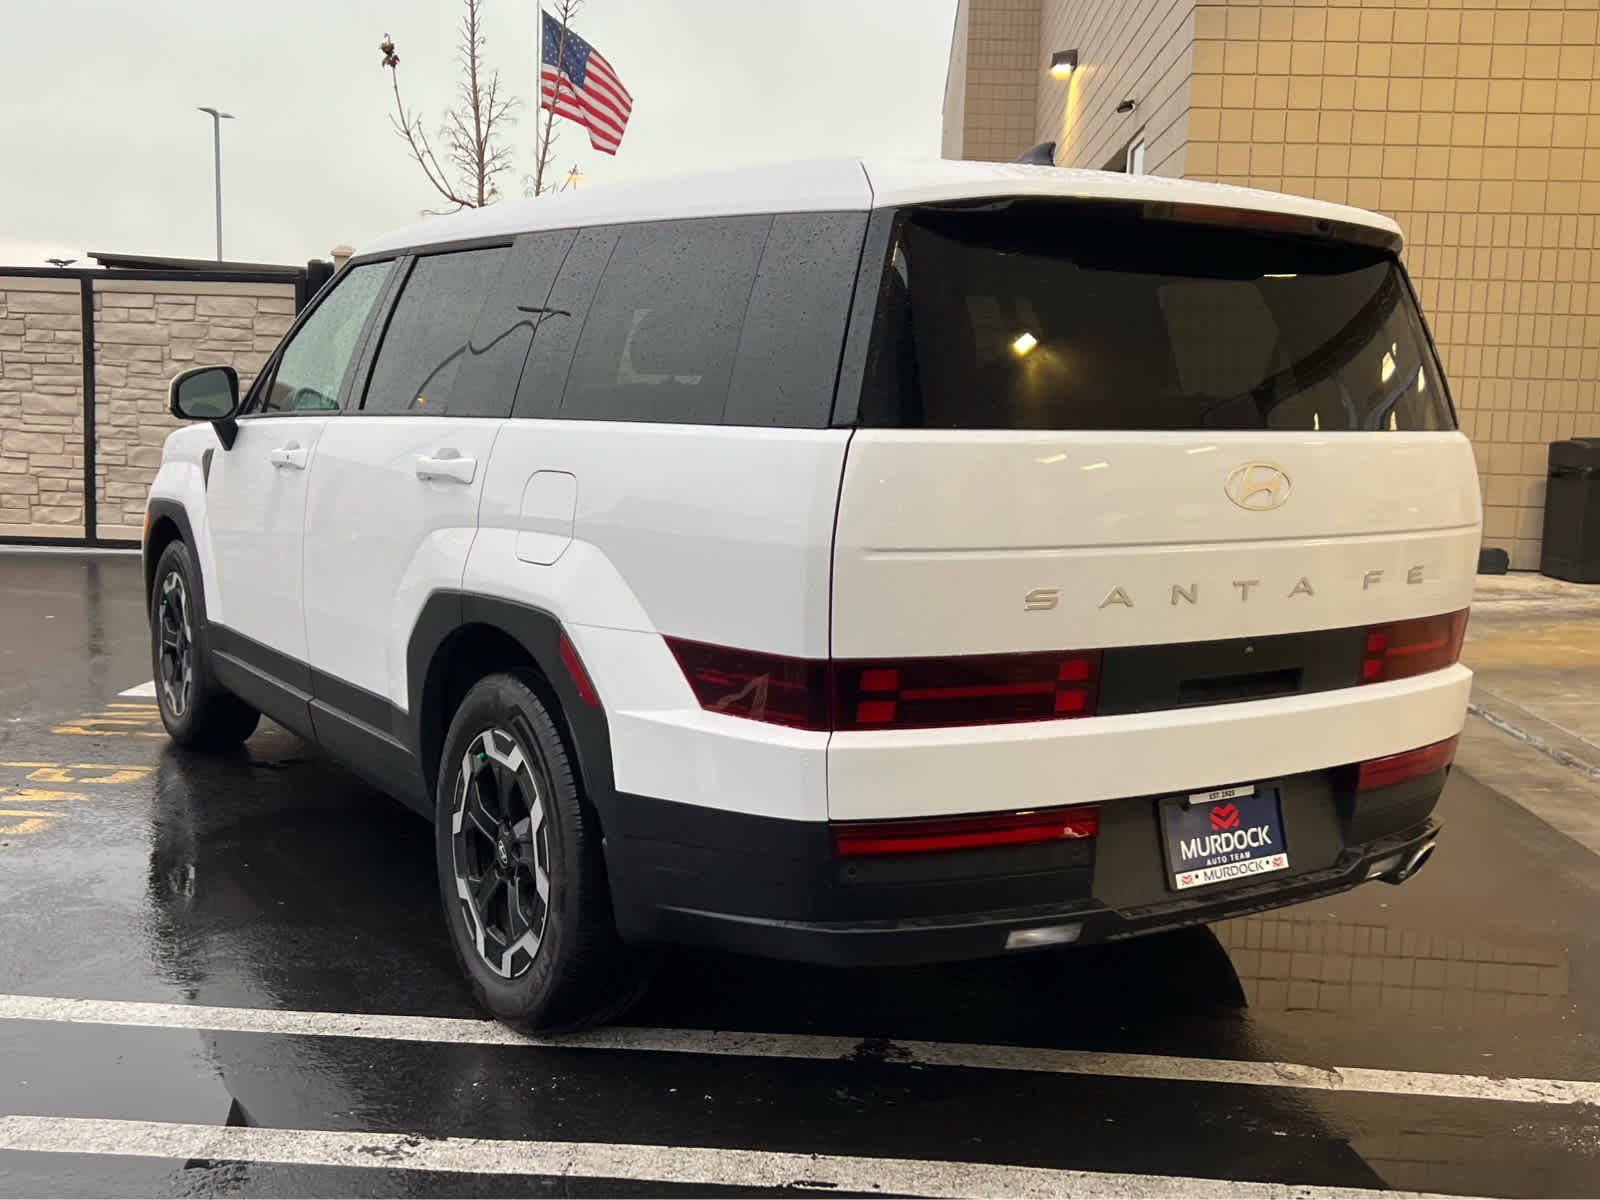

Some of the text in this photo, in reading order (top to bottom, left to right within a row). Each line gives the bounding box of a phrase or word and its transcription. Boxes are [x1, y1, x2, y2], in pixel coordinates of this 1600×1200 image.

[1024, 565, 1425, 611] SANTA FE
[1180, 825, 1272, 860] MURDOCK
[1204, 860, 1265, 881] MURDOCK
[1206, 851, 1251, 866] AUTO TEAM
